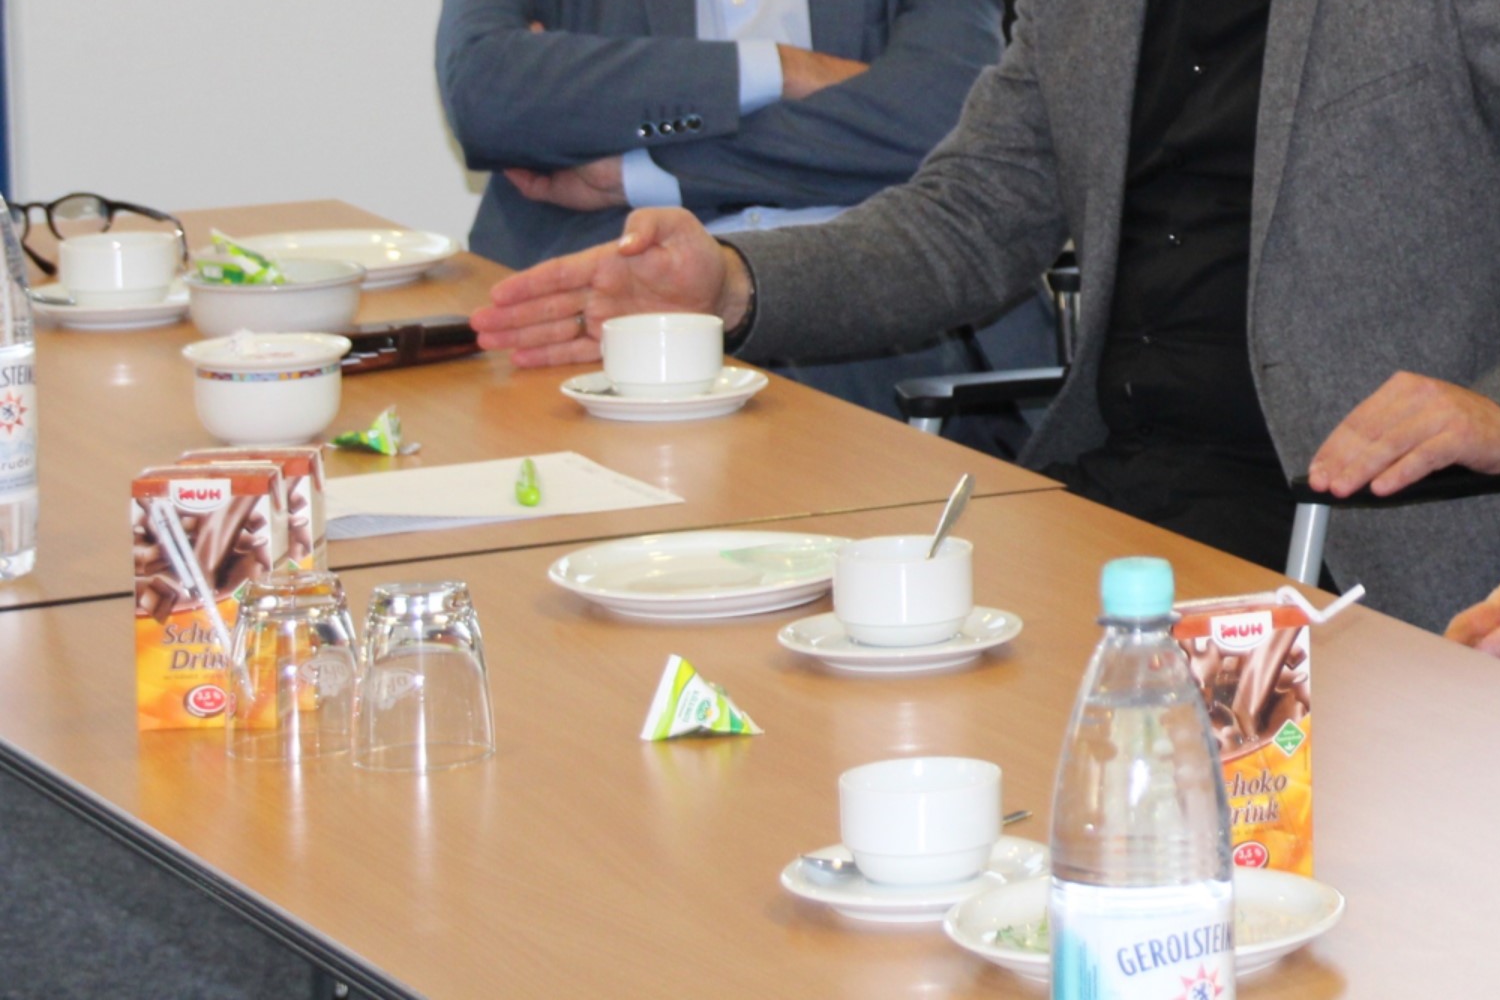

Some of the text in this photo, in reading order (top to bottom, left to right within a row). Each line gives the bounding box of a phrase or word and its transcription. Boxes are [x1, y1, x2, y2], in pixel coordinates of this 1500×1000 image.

[178, 487, 221, 501] MUH
[1221, 623, 1263, 639] MUH
[1227, 769, 1288, 797] hoko
[1231, 799, 1279, 826] rink
